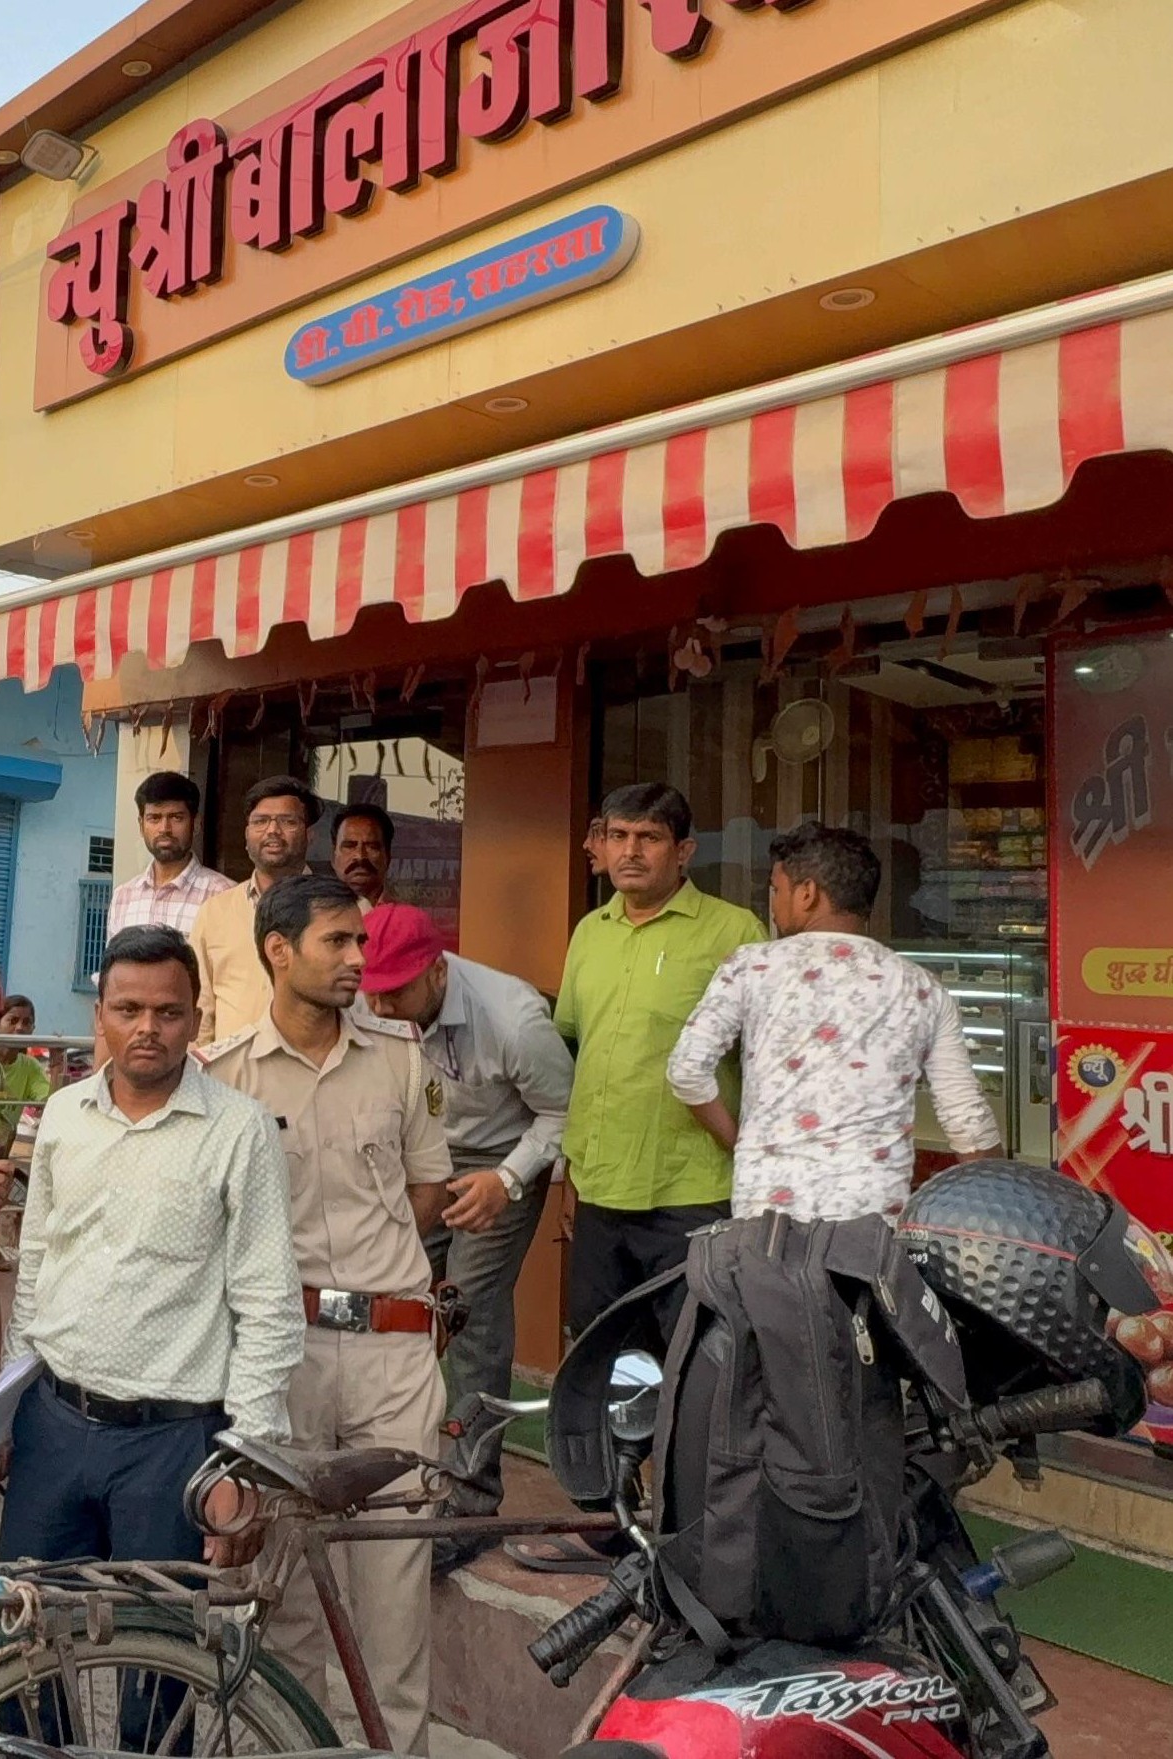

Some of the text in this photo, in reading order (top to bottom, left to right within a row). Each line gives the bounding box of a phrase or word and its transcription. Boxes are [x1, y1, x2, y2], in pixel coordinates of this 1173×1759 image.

[129, 118, 227, 298] श्री
[466, 217, 609, 299] सहरसा
[1107, 961, 1150, 991] शुद्ध
[742, 1671, 957, 1722] Passion
[882, 1703, 961, 1726] PRO
